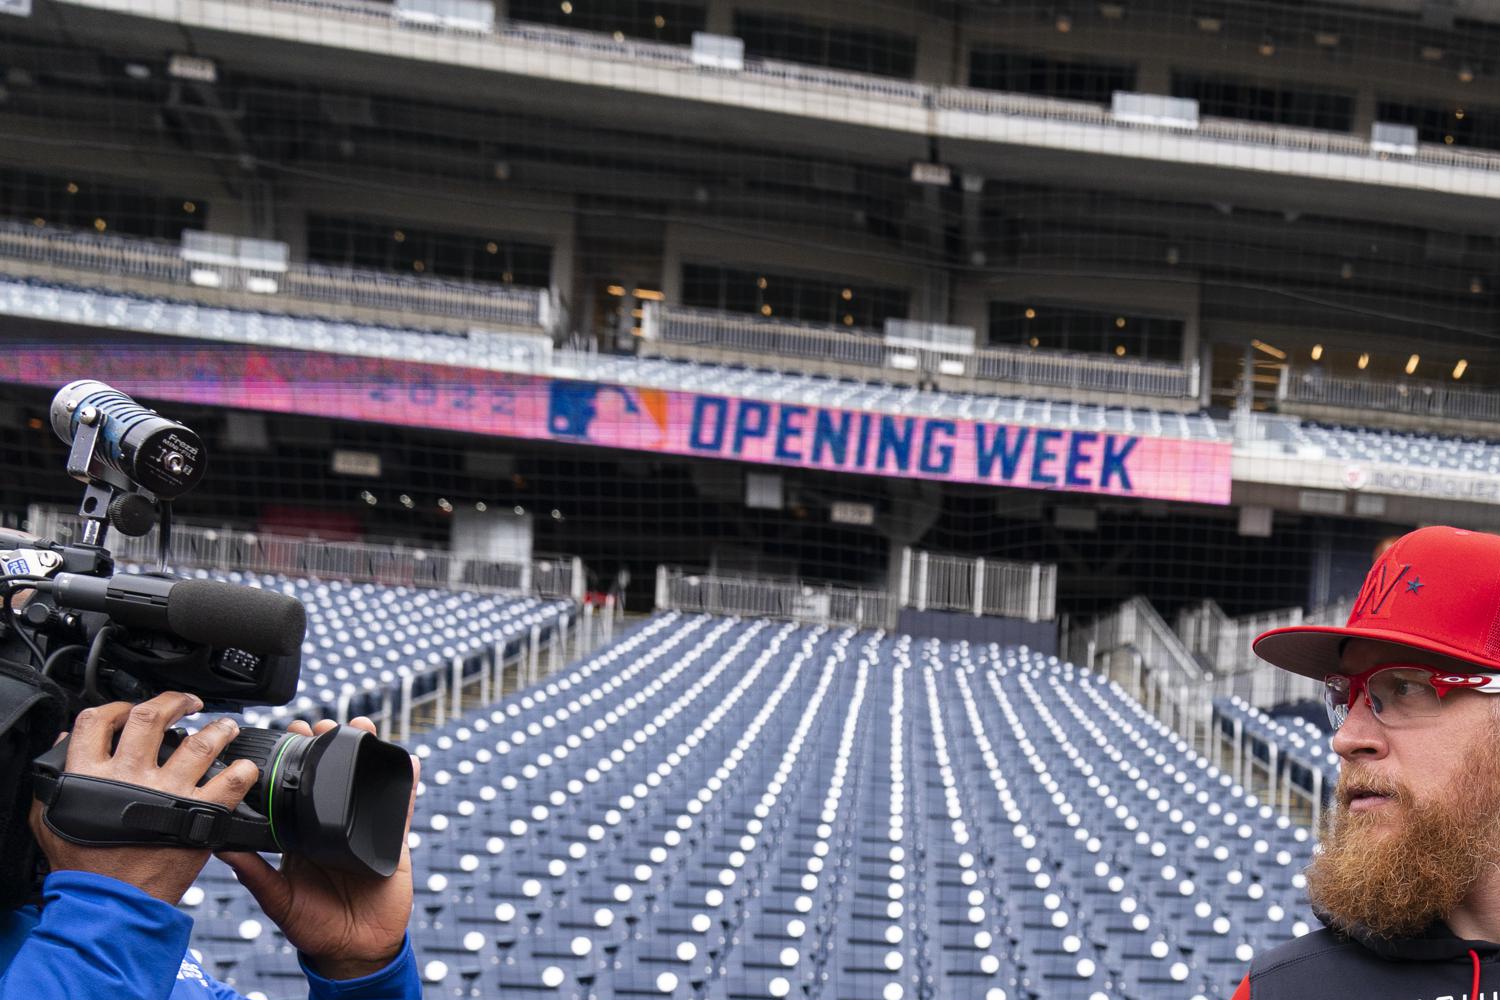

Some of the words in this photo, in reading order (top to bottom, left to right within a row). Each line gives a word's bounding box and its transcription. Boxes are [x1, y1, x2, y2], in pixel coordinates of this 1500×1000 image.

[168, 433, 199, 455] Frezzi
[687, 394, 955, 475] OPENING
[974, 422, 1142, 491] WEEK
